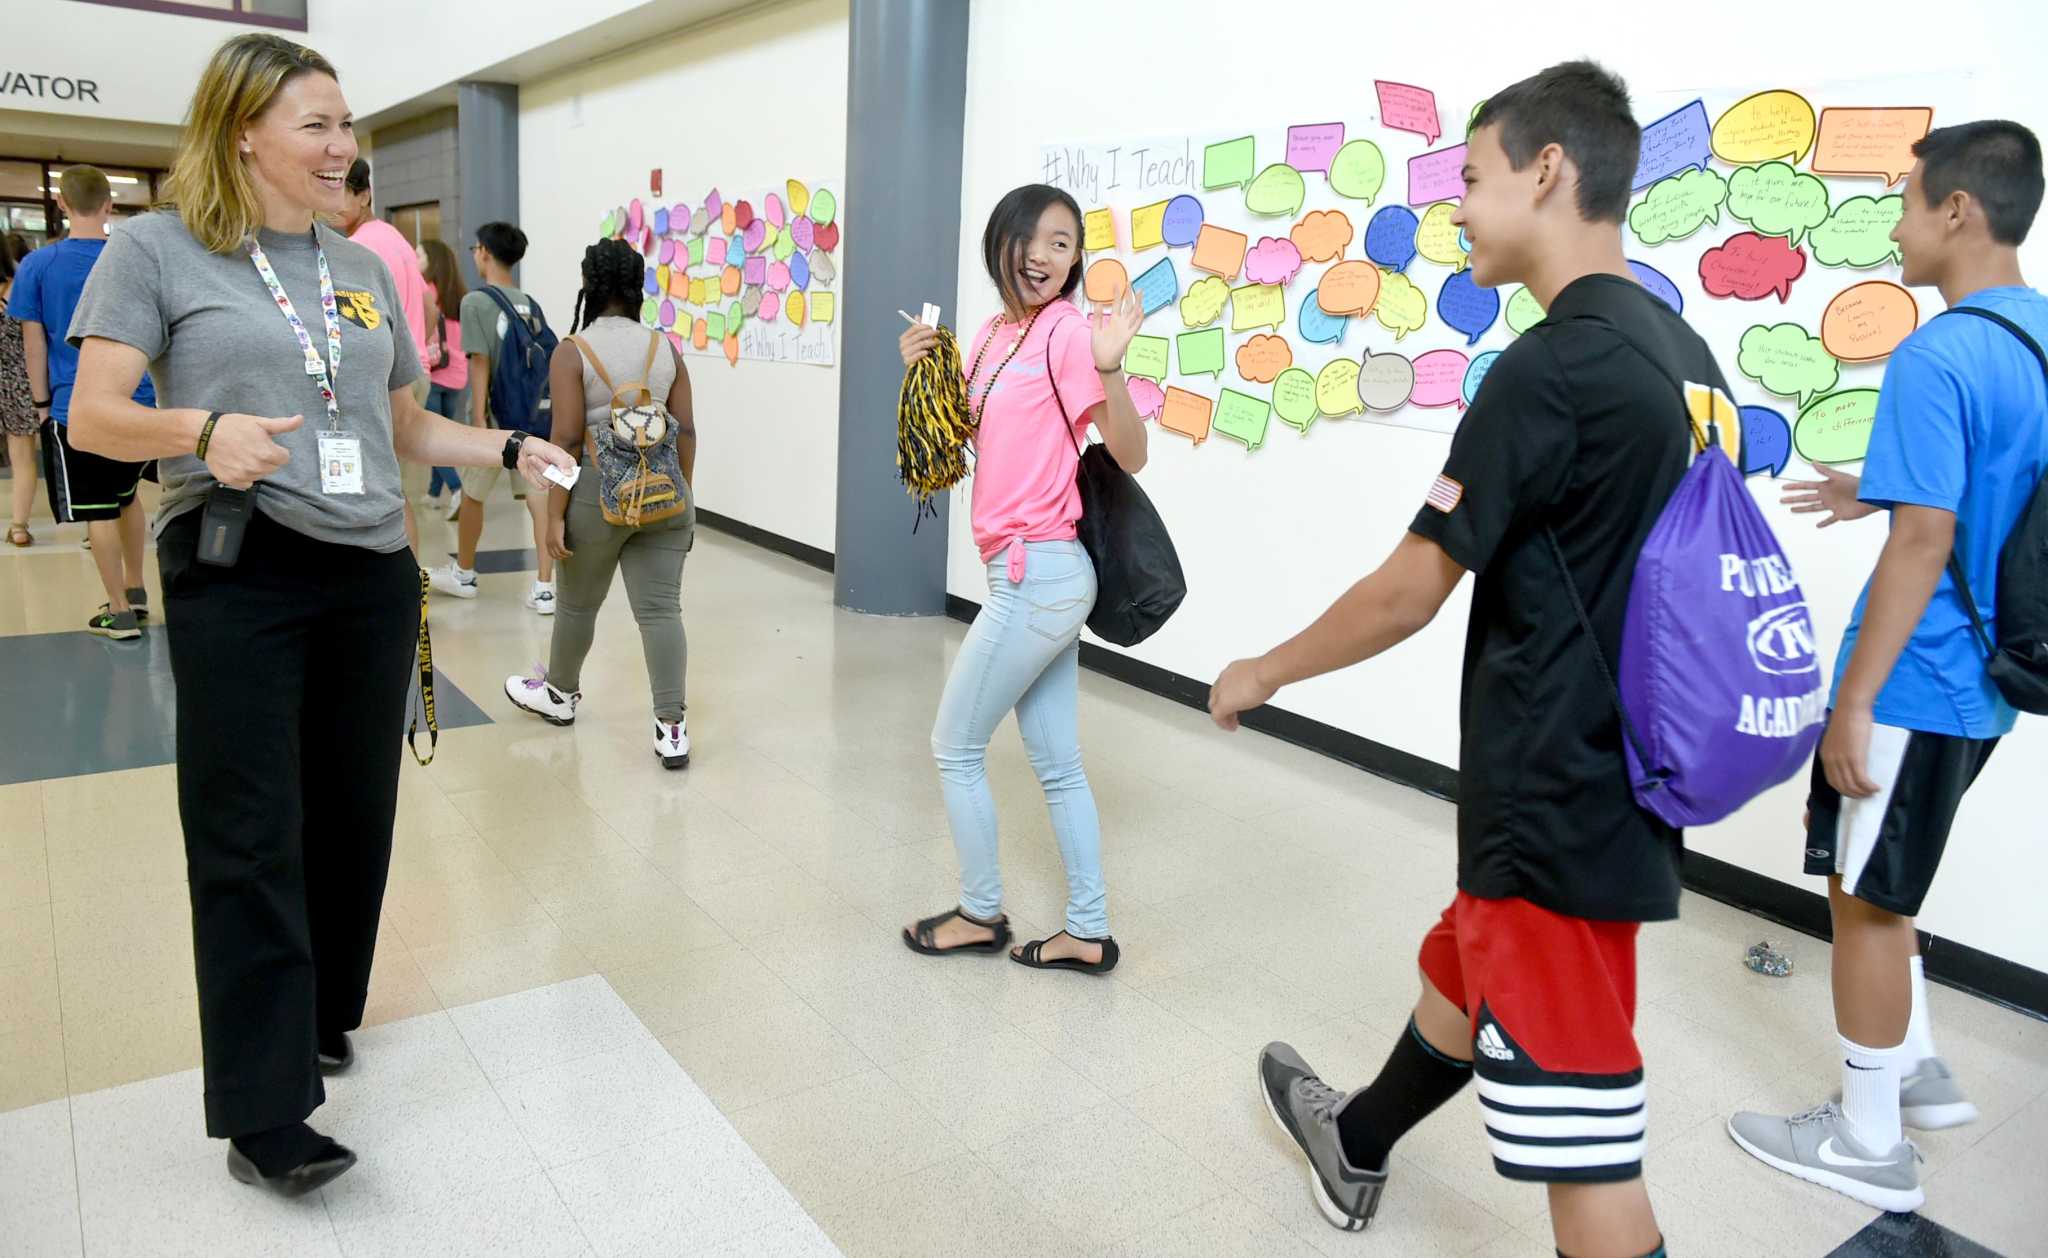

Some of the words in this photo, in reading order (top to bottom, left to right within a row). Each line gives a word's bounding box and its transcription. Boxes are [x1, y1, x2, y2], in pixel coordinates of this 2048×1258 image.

[1043, 147, 1099, 204] #Why
[1107, 147, 1122, 190] I
[778, 332, 788, 360] I
